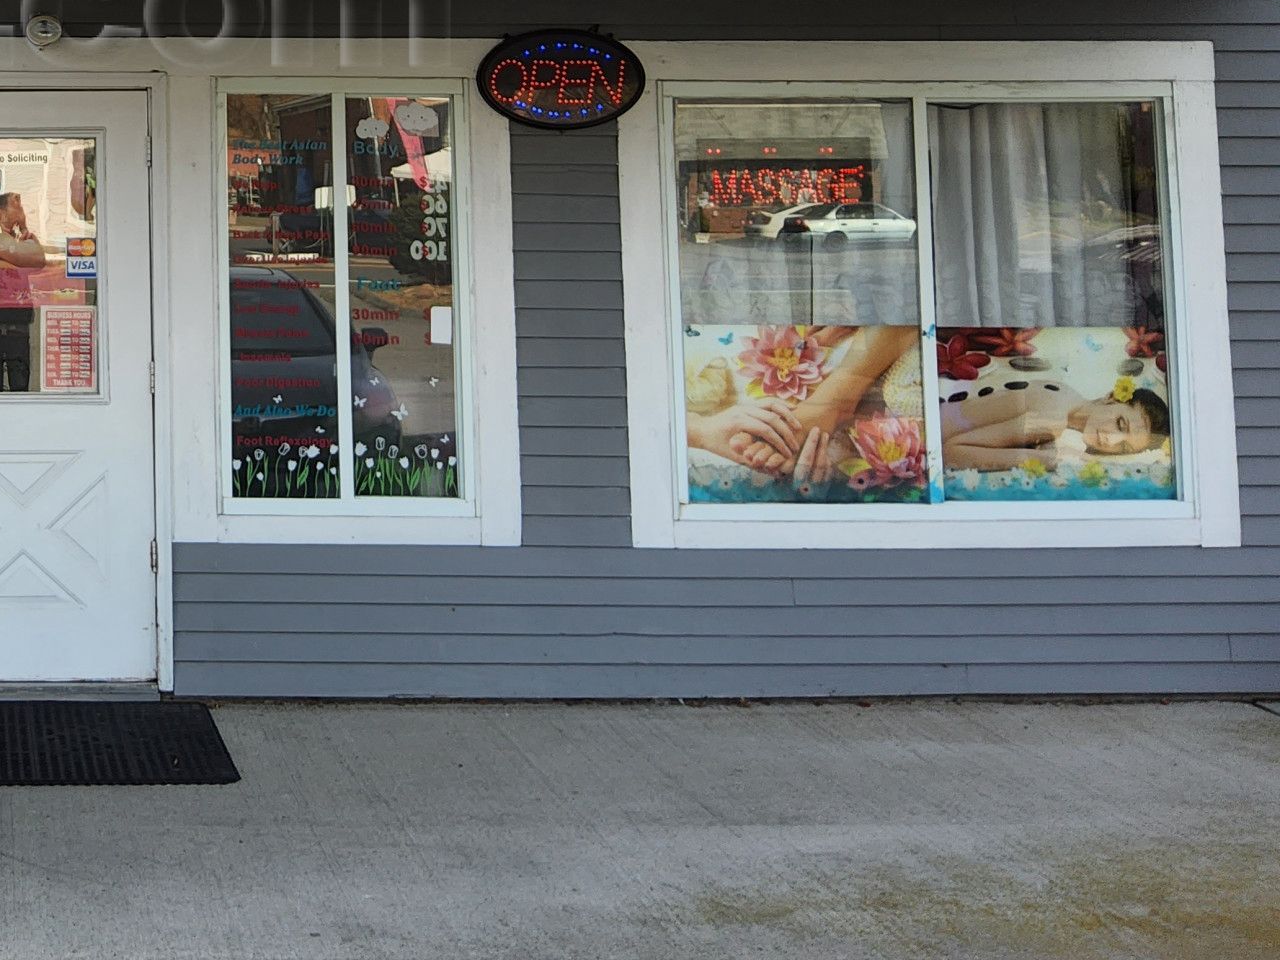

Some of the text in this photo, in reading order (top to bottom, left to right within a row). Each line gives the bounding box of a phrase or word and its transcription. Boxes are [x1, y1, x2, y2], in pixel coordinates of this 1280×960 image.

[490, 58, 627, 105] OPEN
[289, 139, 328, 151] Asian
[353, 141, 399, 158] Body
[7, 152, 48, 164] Soliciting
[708, 164, 865, 205] MASSAGE
[70, 260, 95, 270] VISA
[352, 308, 401, 321] 30min
[234, 404, 261, 417] And
[316, 405, 337, 417] Do
[236, 435, 333, 449] Foot Reflexology
